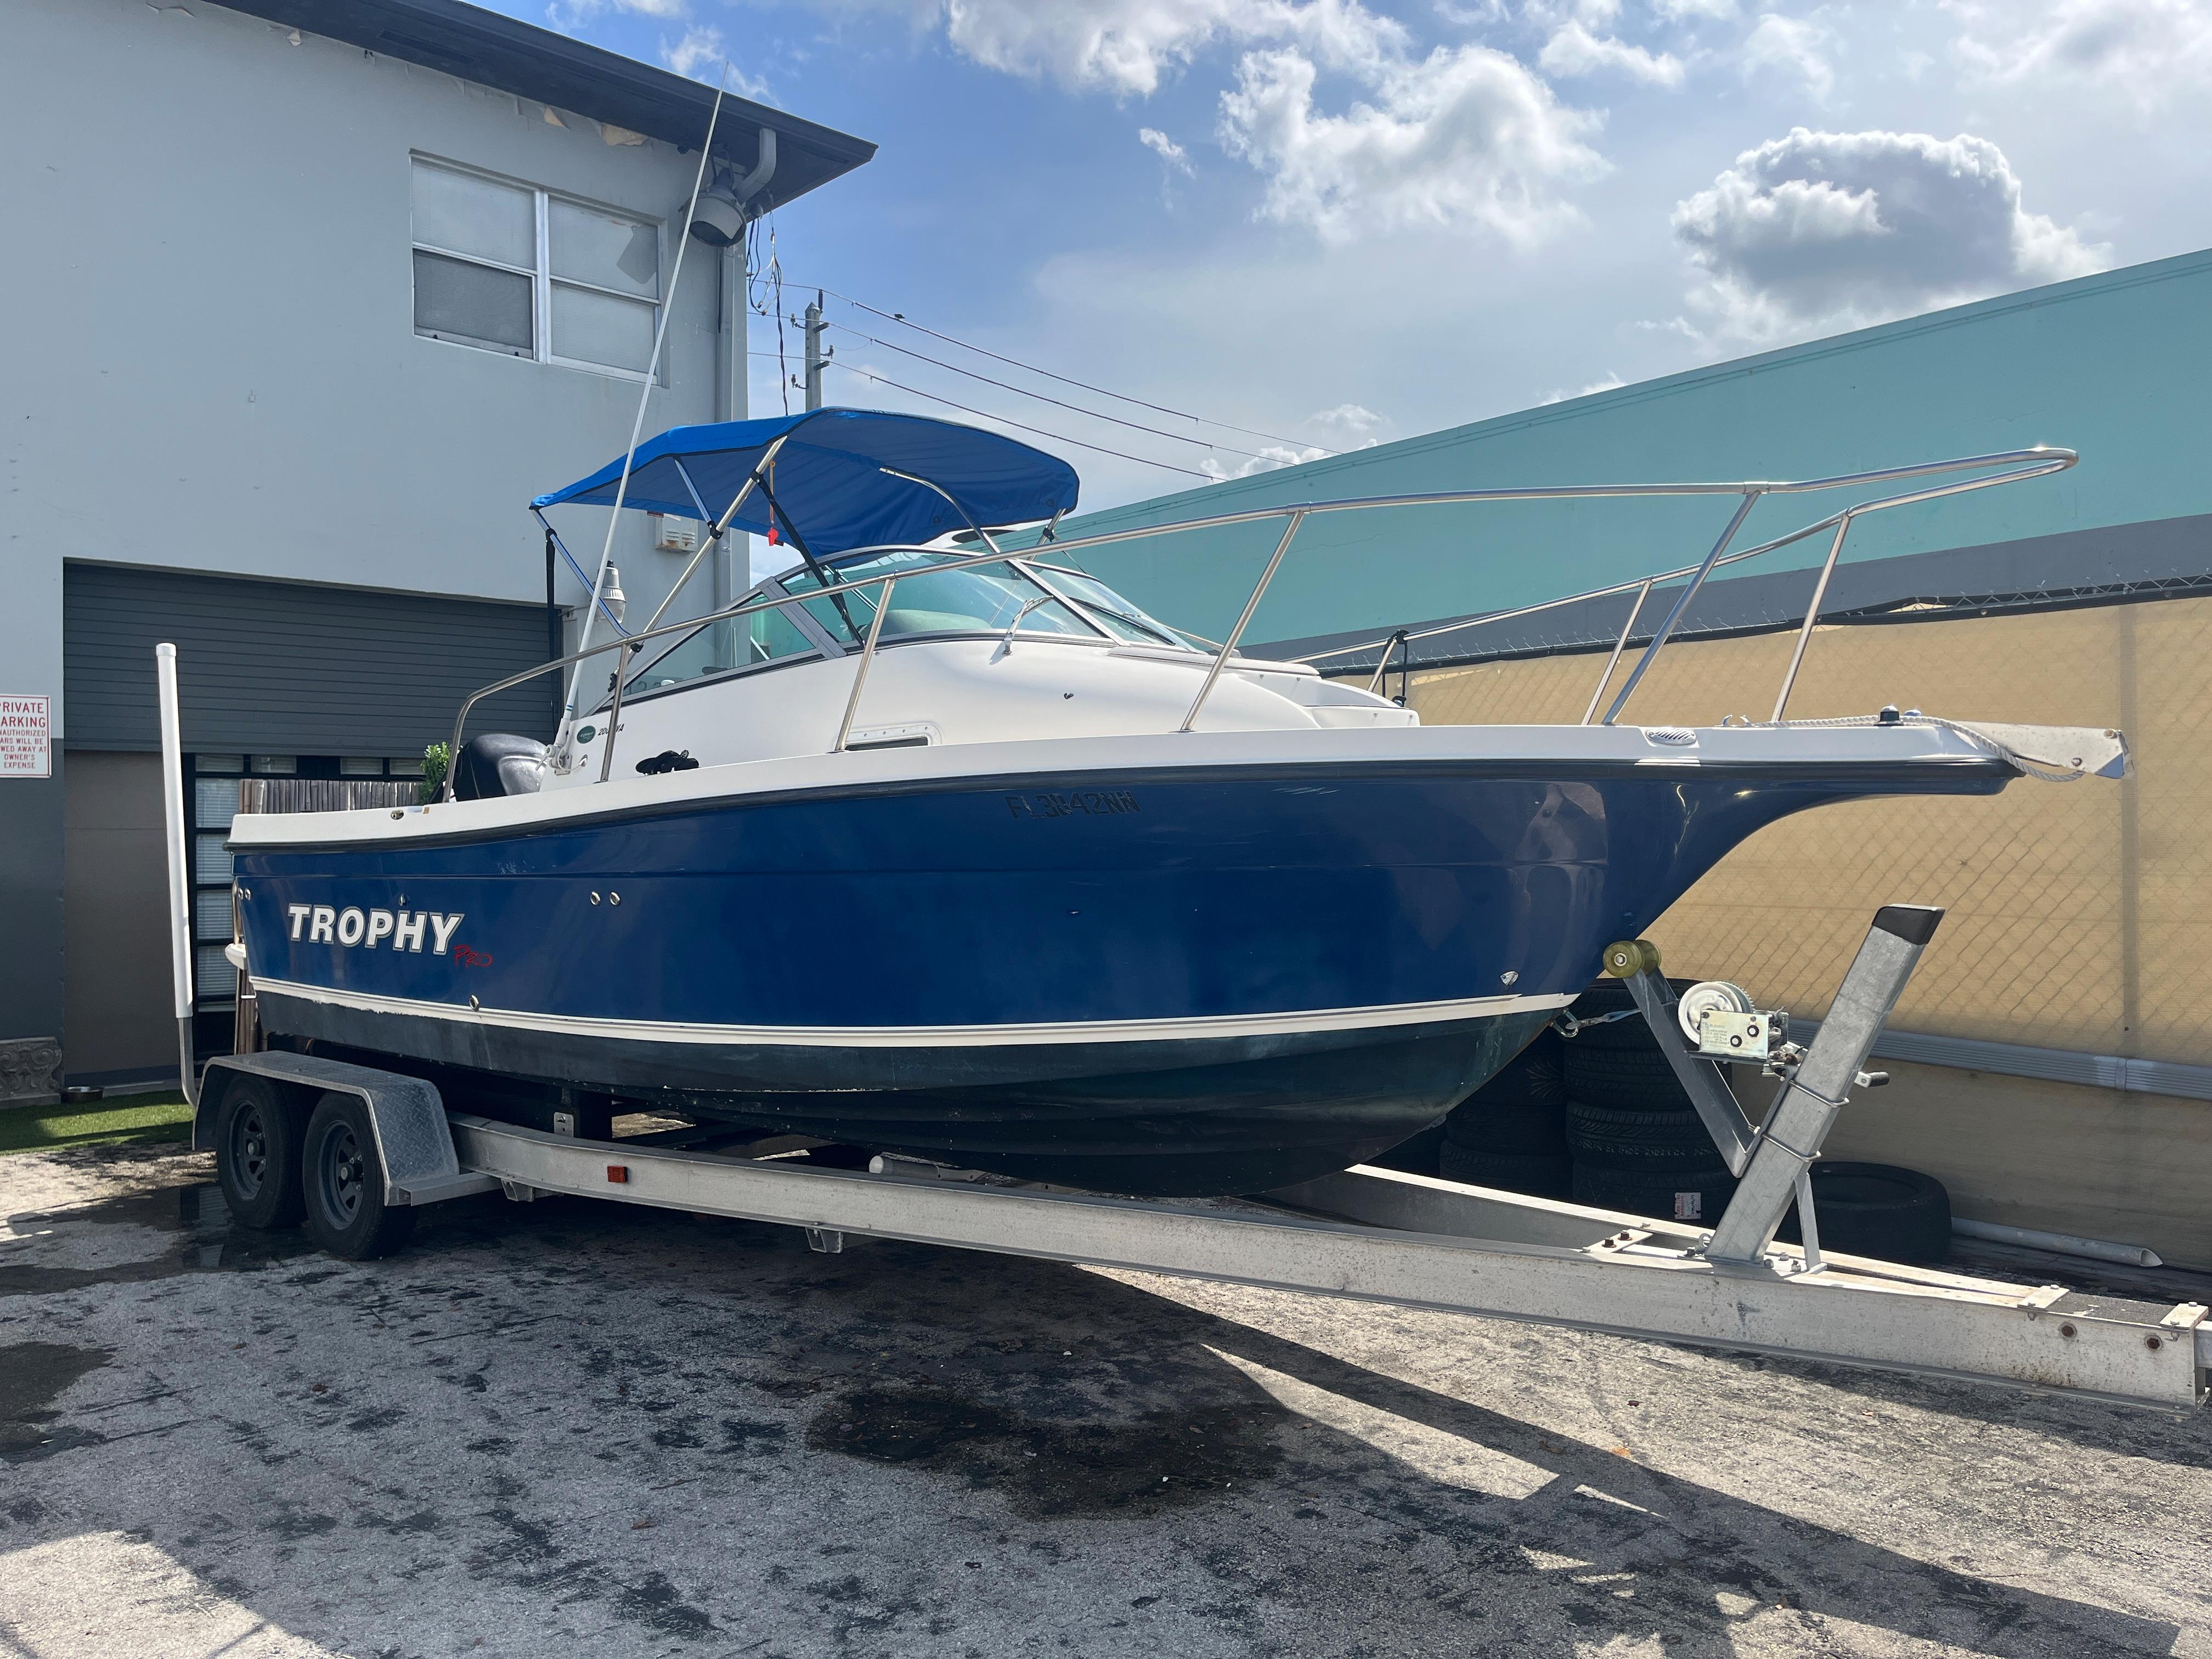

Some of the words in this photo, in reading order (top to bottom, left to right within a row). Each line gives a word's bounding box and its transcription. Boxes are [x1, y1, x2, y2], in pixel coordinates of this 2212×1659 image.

[0, 702, 44, 713] RIVATE
[1, 716, 46, 727] ARKING
[287, 902, 465, 956] TROPHY
